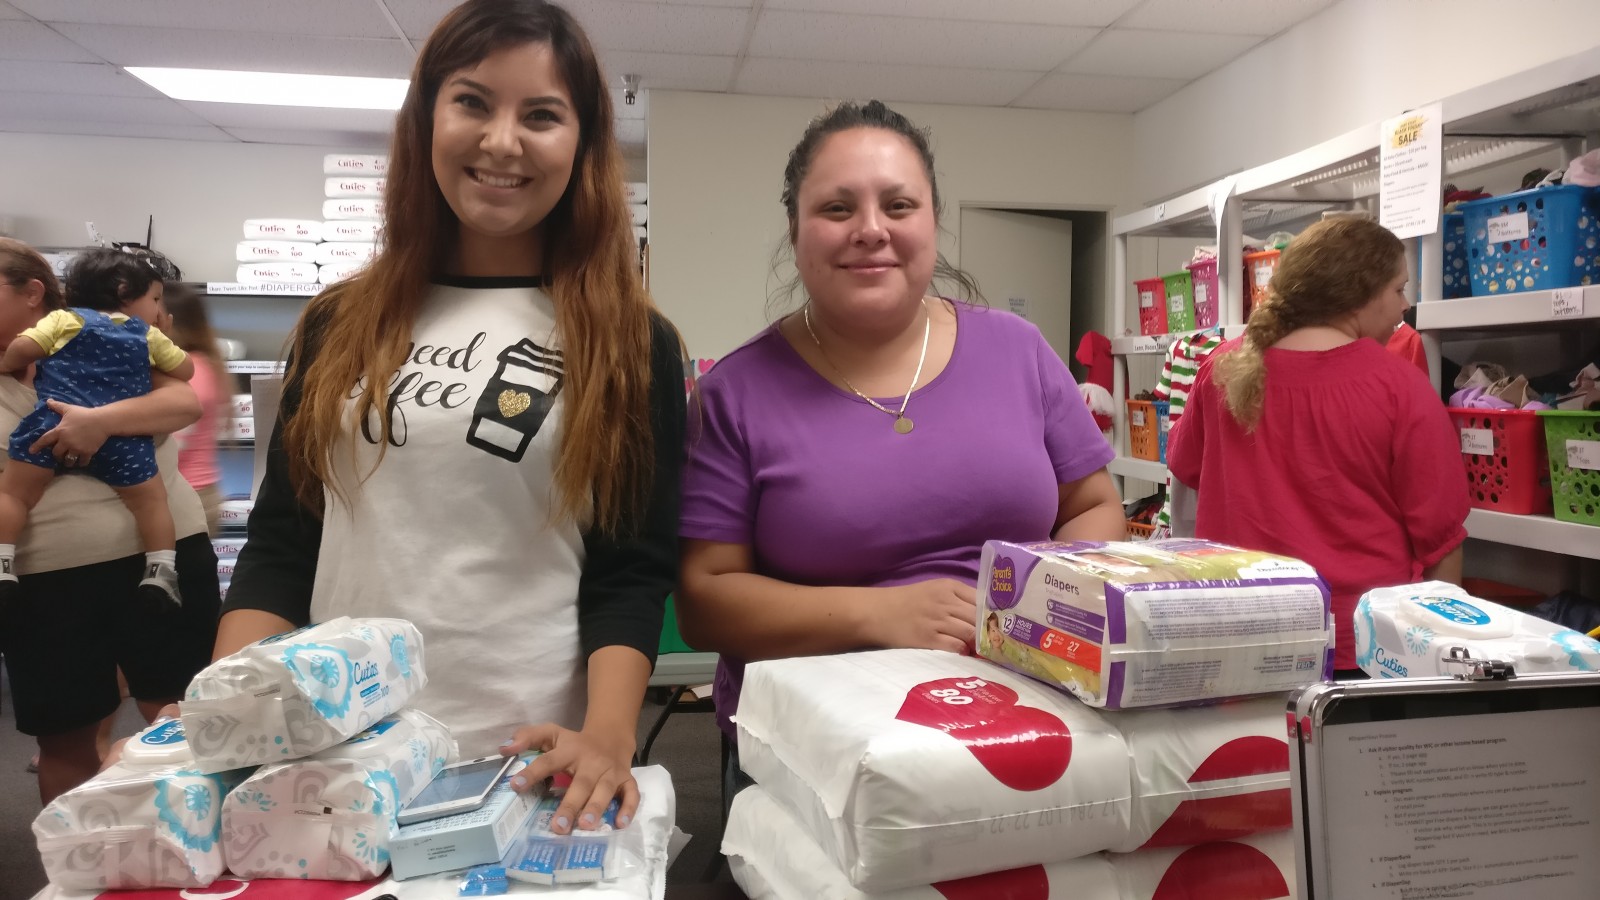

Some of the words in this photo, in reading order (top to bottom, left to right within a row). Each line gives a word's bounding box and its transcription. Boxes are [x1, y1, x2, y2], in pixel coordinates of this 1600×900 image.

[1398, 131, 1418, 146] SALE
[338, 160, 364, 168] Cuties
[340, 182, 366, 190] Cuties
[338, 204, 364, 212] Cuties
[216, 545, 237, 553] uties
[992, 566, 1012, 579] Parent's
[992, 579, 1012, 592] Choice
[1044, 573, 1080, 596] Diapers
[1004, 617, 1012, 628] 12
[1043, 633, 1055, 648] 5
[1067, 641, 1080, 652] 27
[1376, 648, 1408, 678] Cuties
[353, 660, 379, 686] Cuties
[956, 679, 987, 690] 5
[930, 688, 974, 704] 80
